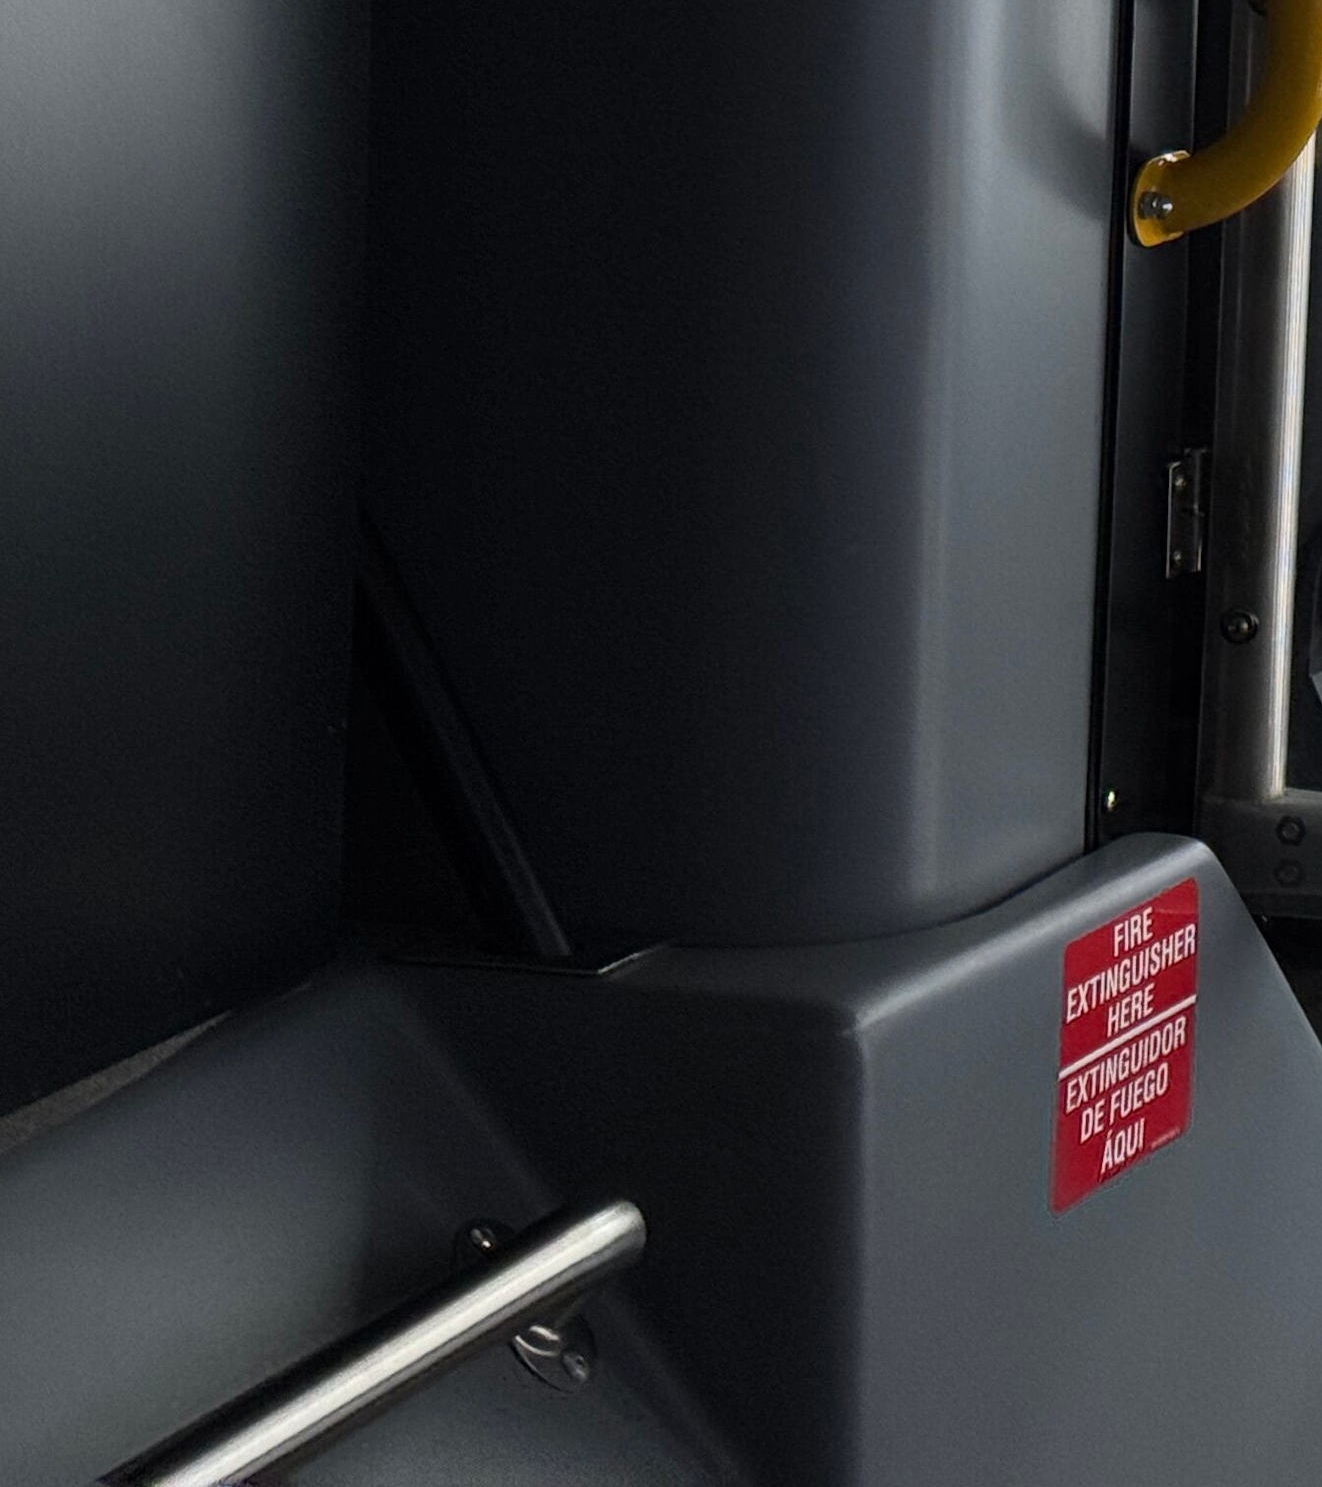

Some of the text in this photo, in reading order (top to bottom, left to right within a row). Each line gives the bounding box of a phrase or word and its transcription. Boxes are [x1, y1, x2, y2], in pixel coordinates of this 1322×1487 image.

[1113, 906, 1155, 958] FIRE
[1066, 923, 1196, 1024] EXTINGUISHER
[1107, 983, 1155, 1038] HERE
[1065, 1015, 1187, 1114] EXTINGUIDOR
[1080, 1062, 1169, 1144] DE FUEGO
